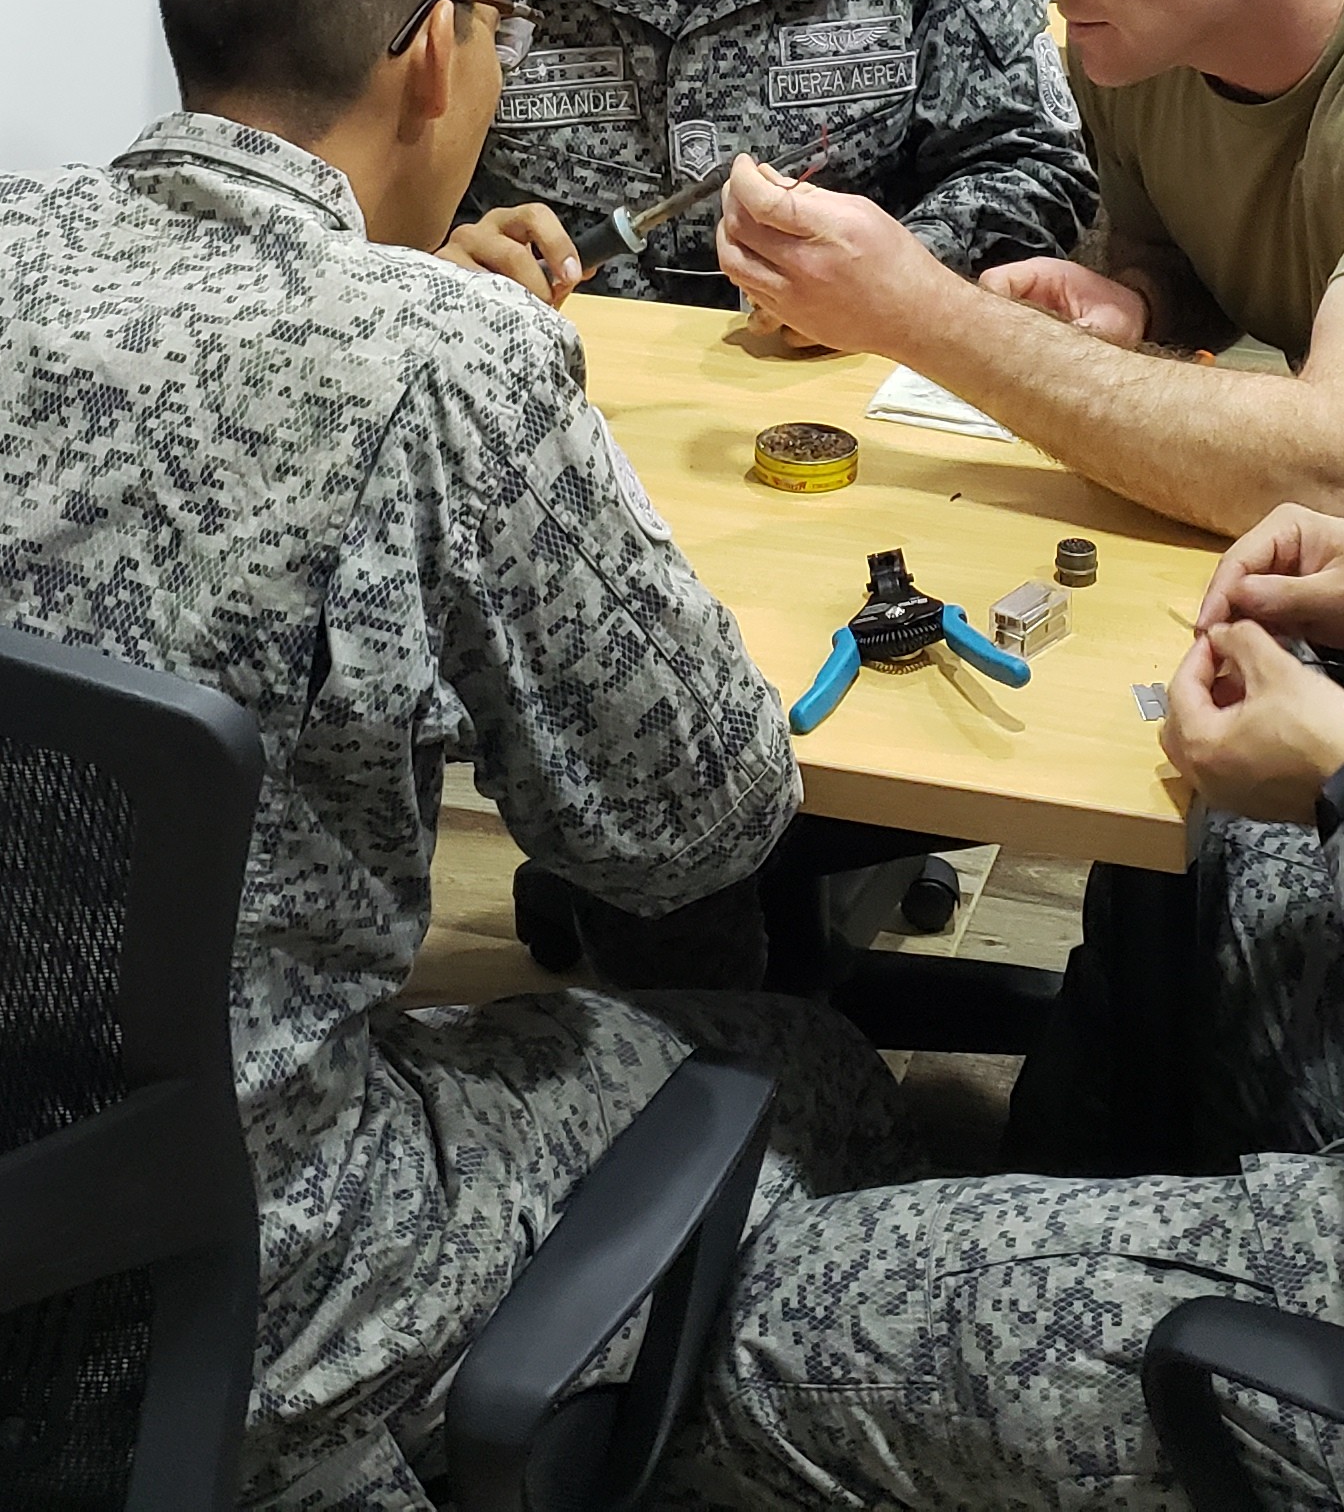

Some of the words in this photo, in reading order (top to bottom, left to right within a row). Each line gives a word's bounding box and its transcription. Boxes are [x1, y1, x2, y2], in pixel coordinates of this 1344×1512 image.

[777, 69, 845, 98] FUERZA
[851, 62, 908, 89] AEREA
[500, 90, 631, 120] HERNANDEZ
